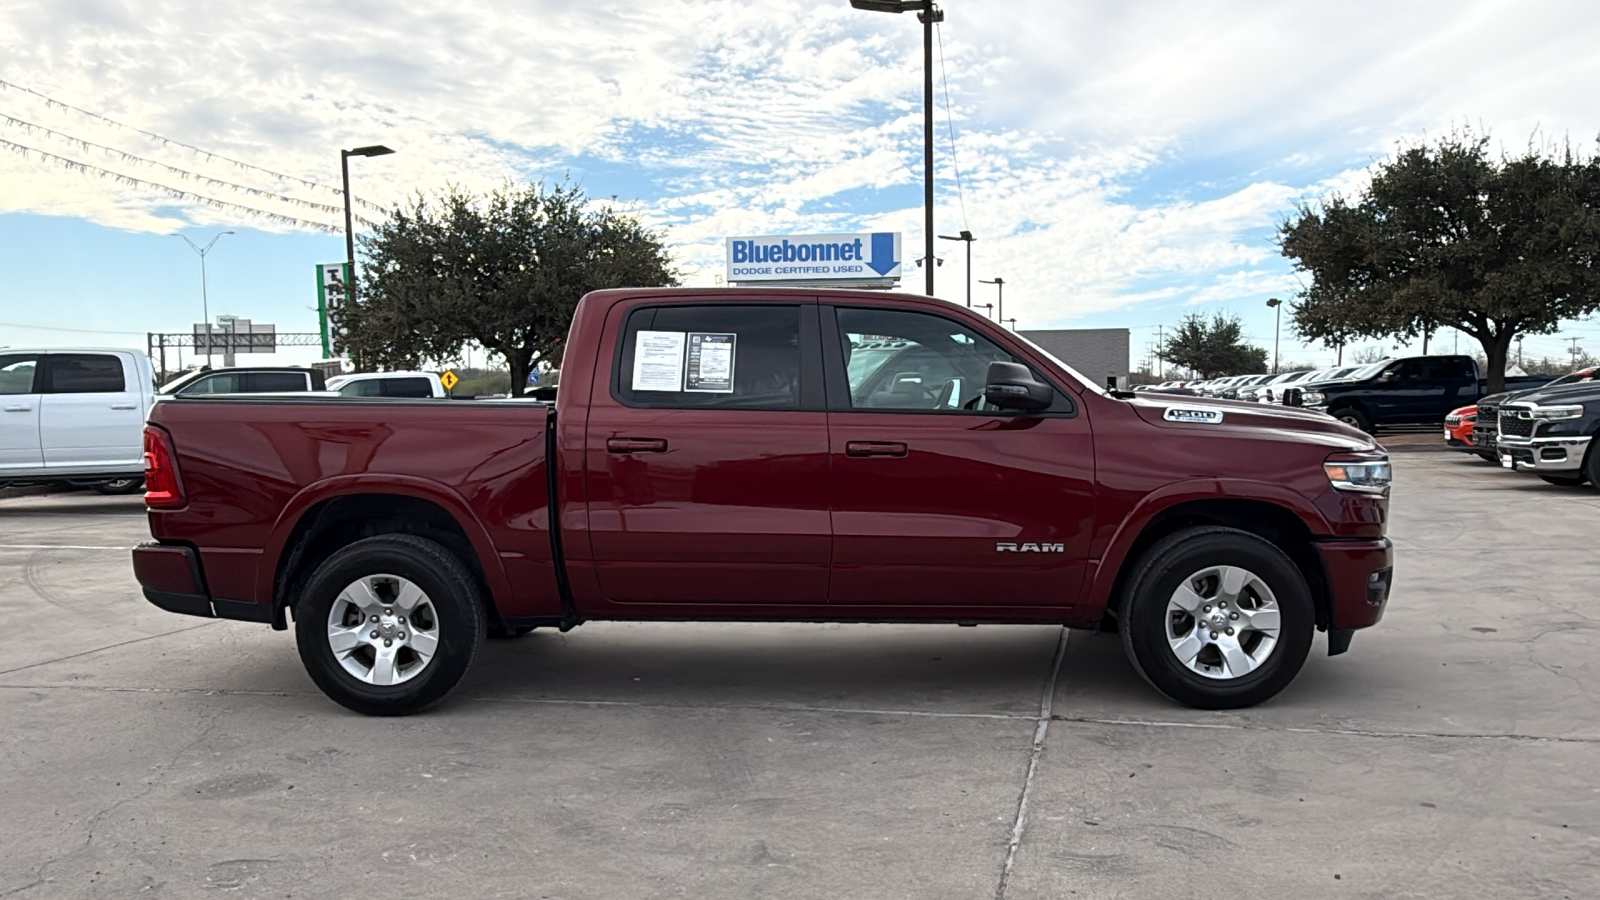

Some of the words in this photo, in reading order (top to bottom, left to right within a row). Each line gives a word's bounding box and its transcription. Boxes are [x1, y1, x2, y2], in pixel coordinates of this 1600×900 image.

[732, 238, 863, 263] Bluebonnet
[733, 266, 772, 275] DODGE
[774, 266, 830, 274] CERTIFIED
[833, 265, 863, 273] USED
[1171, 409, 1216, 418] 1500
[996, 542, 1064, 552] RAM
